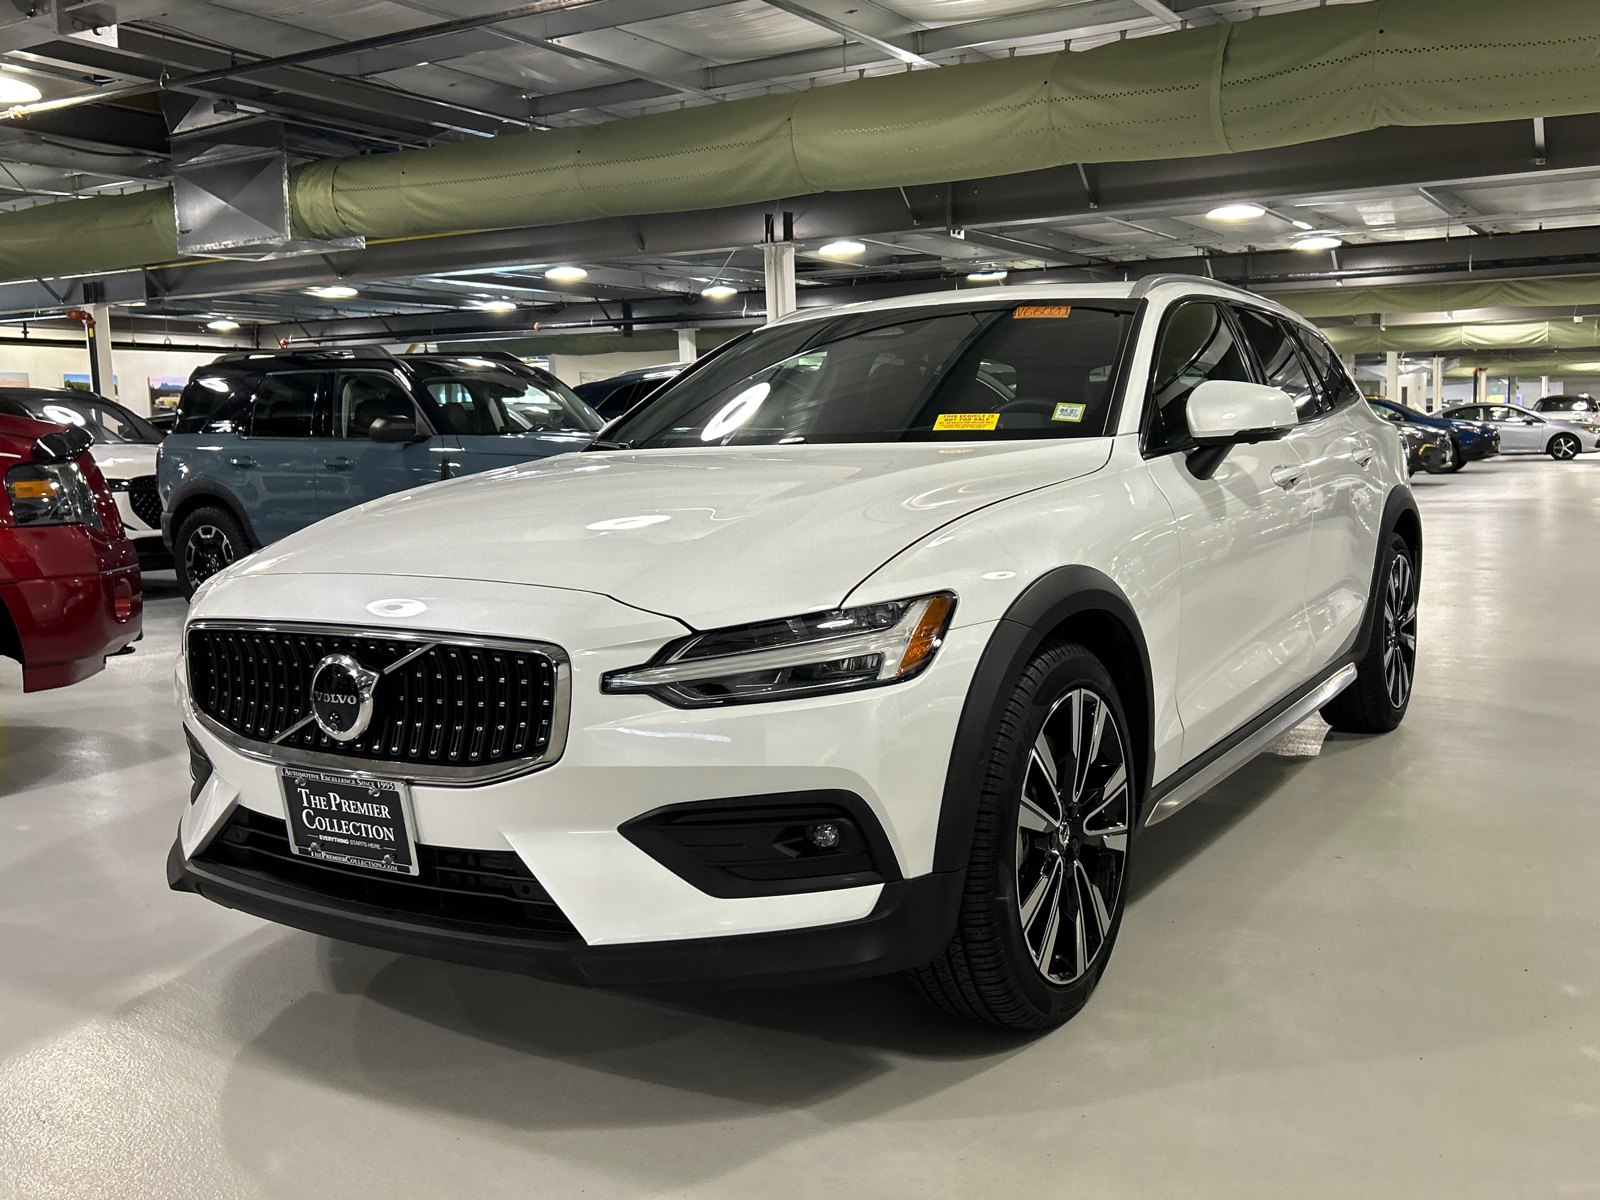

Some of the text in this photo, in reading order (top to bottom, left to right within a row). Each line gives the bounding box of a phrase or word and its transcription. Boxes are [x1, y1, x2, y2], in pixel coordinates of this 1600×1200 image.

[314, 690, 357, 705] VOLVO
[376, 781, 395, 790] 1995
[297, 787, 392, 819] THE PREMIER
[302, 808, 396, 841] COLLECTION
[319, 834, 350, 845] EVERYTHING
[349, 839, 368, 848] STARTS
